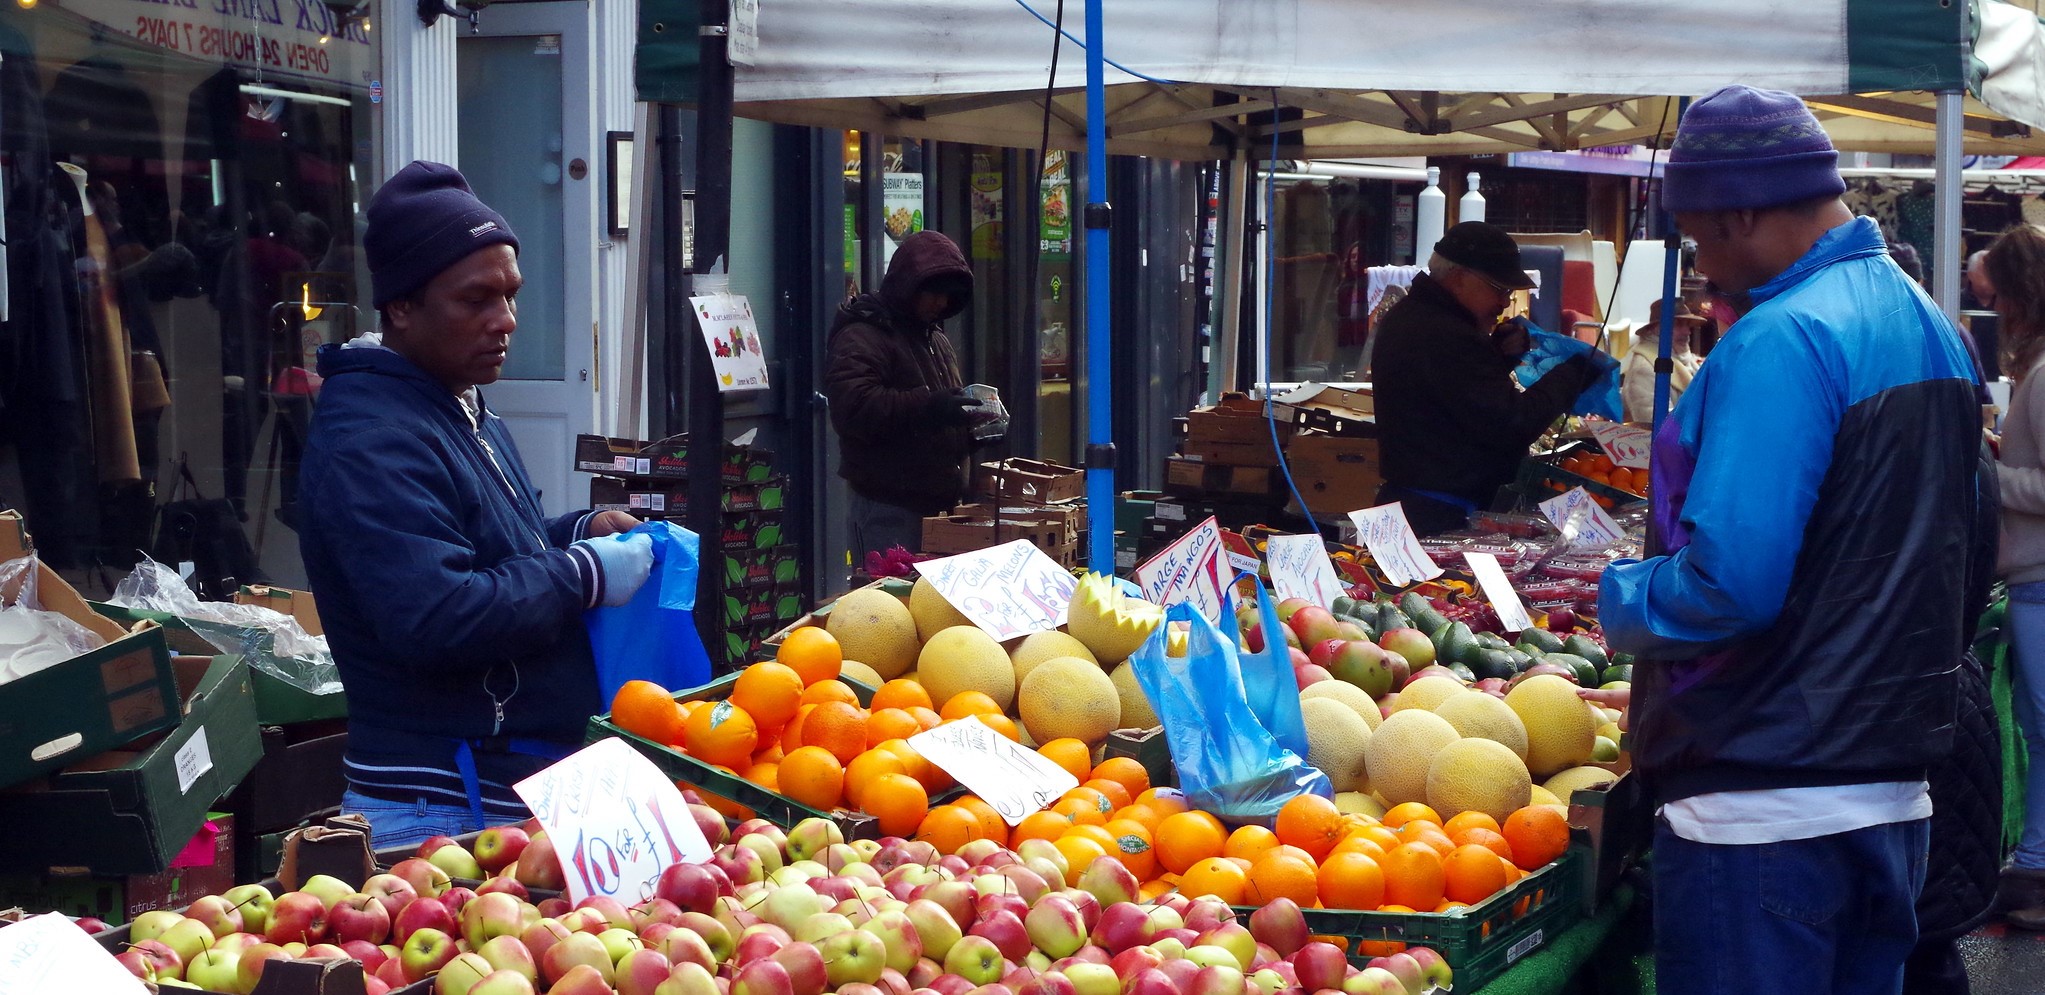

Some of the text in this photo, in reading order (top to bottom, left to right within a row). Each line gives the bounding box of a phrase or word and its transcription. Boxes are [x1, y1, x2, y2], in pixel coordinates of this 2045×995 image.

[904, 177, 923, 190] Platters
[929, 558, 957, 593] SWEET
[962, 556, 995, 587] GALIA
[996, 544, 1031, 584] MELONS
[1173, 525, 1213, 593] MANGOS
[1241, 559, 1258, 570] JAPAN
[1145, 552, 1178, 605] LARGE
[532, 772, 560, 821] SWEET
[572, 828, 620, 897] 10
[615, 827, 635, 861] FOR
[130, 900, 157, 914] citrus
